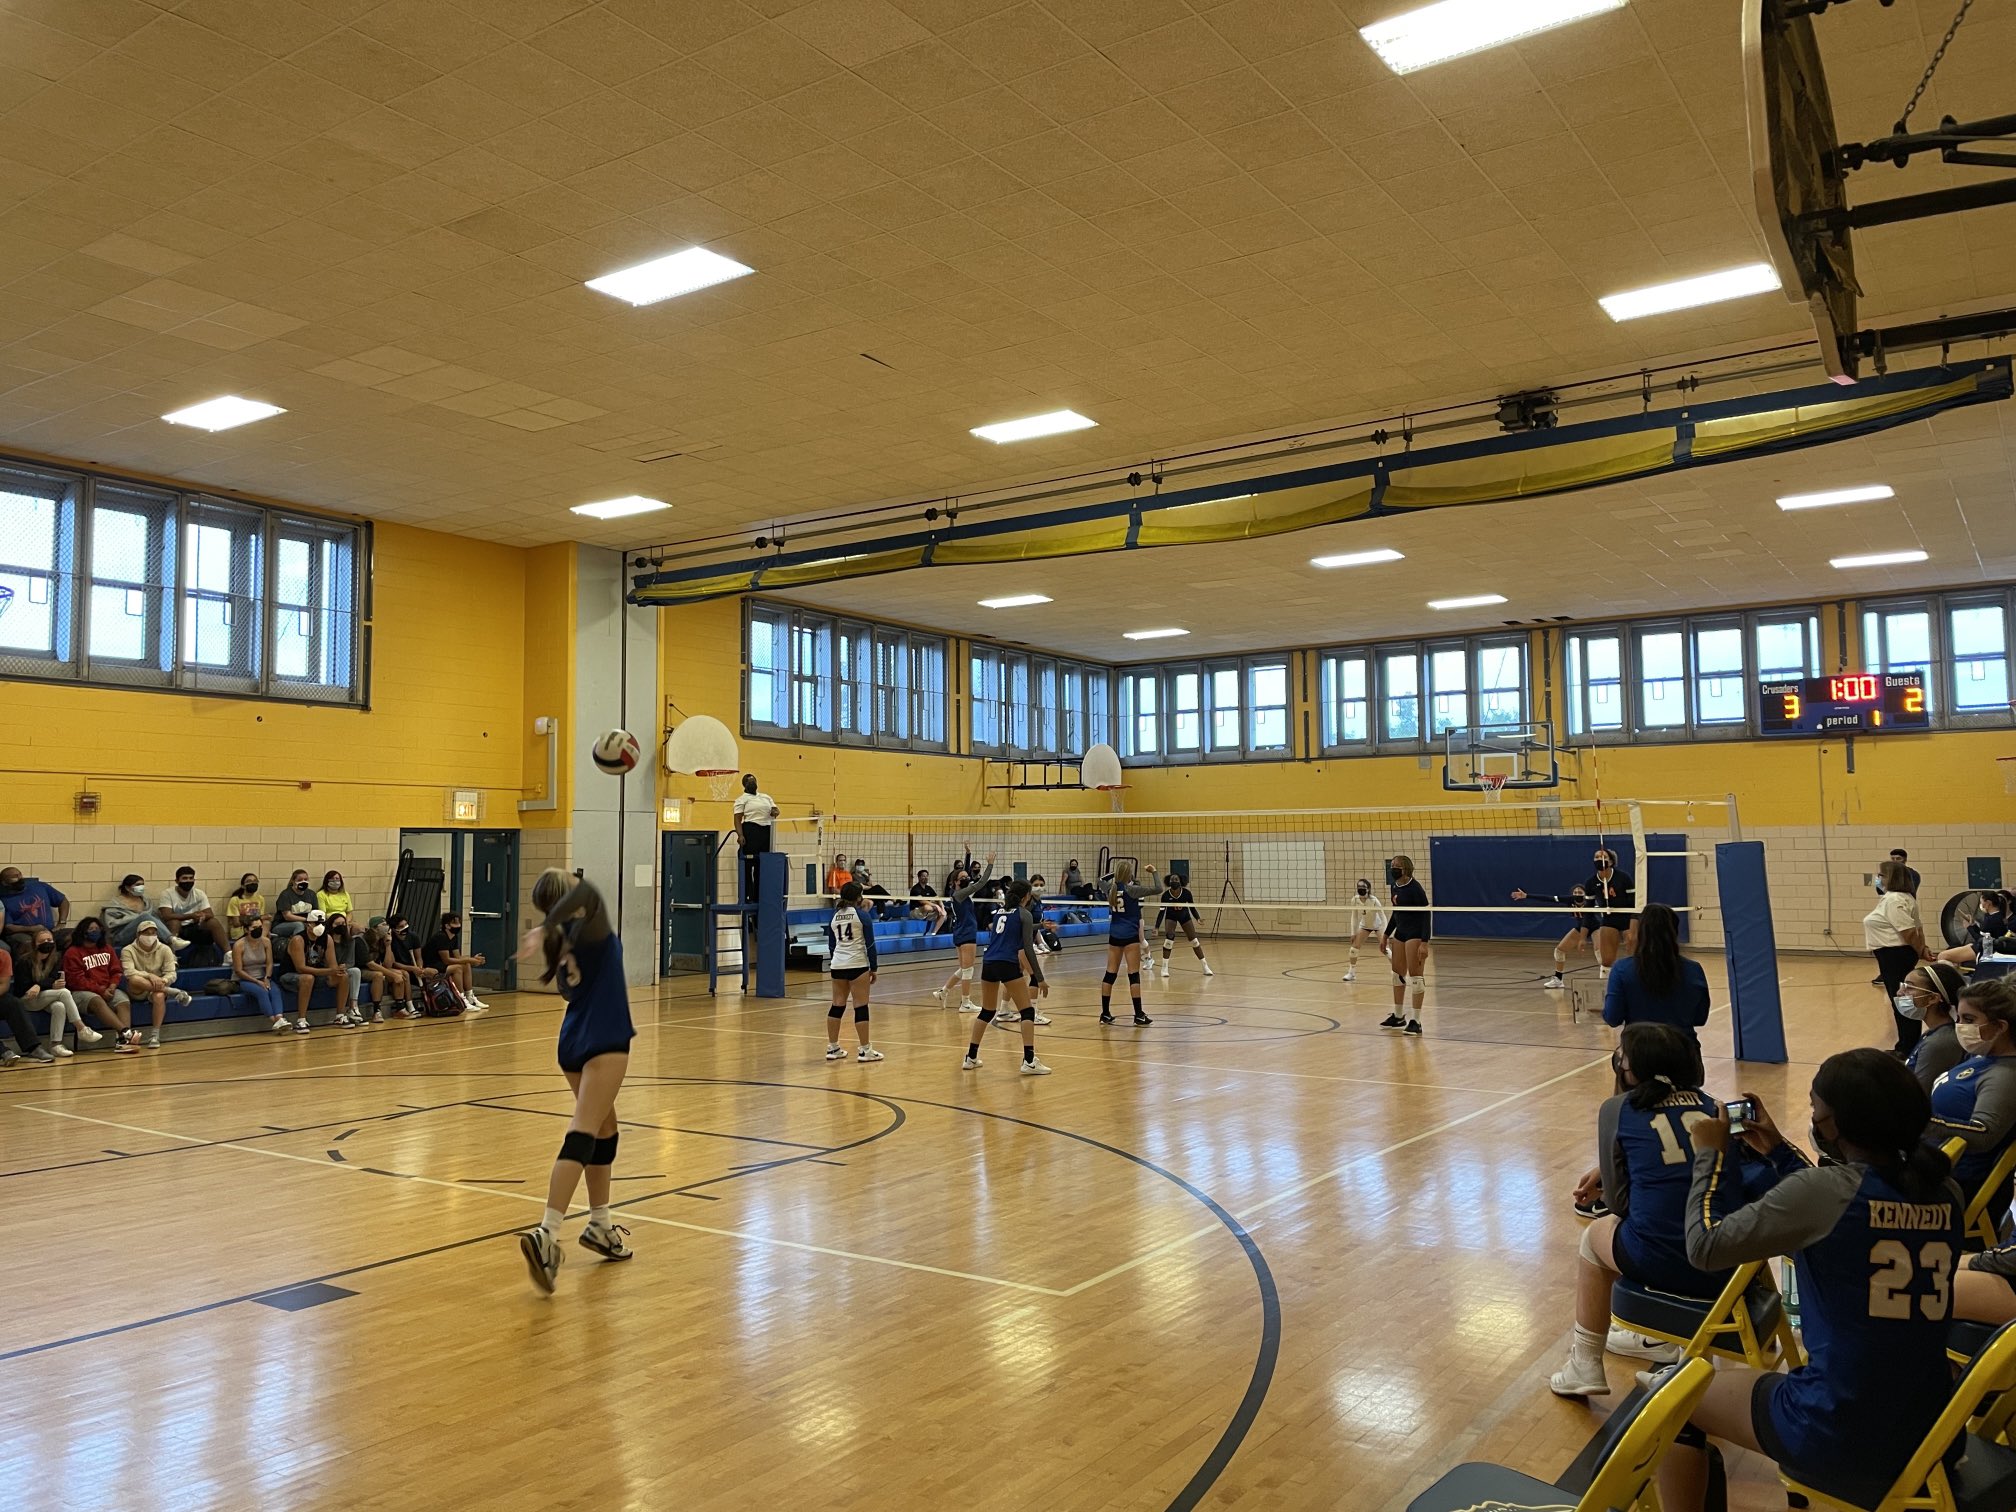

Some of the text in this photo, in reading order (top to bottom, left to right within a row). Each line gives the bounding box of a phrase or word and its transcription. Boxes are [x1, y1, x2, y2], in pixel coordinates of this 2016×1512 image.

[1762, 684, 1799, 695] Crusaders
[1831, 677, 1876, 700] 1:00
[1885, 676, 1920, 687] Guests
[1784, 695, 1800, 719] 3
[1905, 688, 1923, 712] 2
[1826, 710, 1880, 727] period 1
[458, 804, 474, 817] EXIT
[836, 923, 853, 941] 14
[995, 915, 1007, 934] 6
[1868, 1199, 1952, 1231] KENNEDY
[1868, 1239, 1953, 1321] 23
